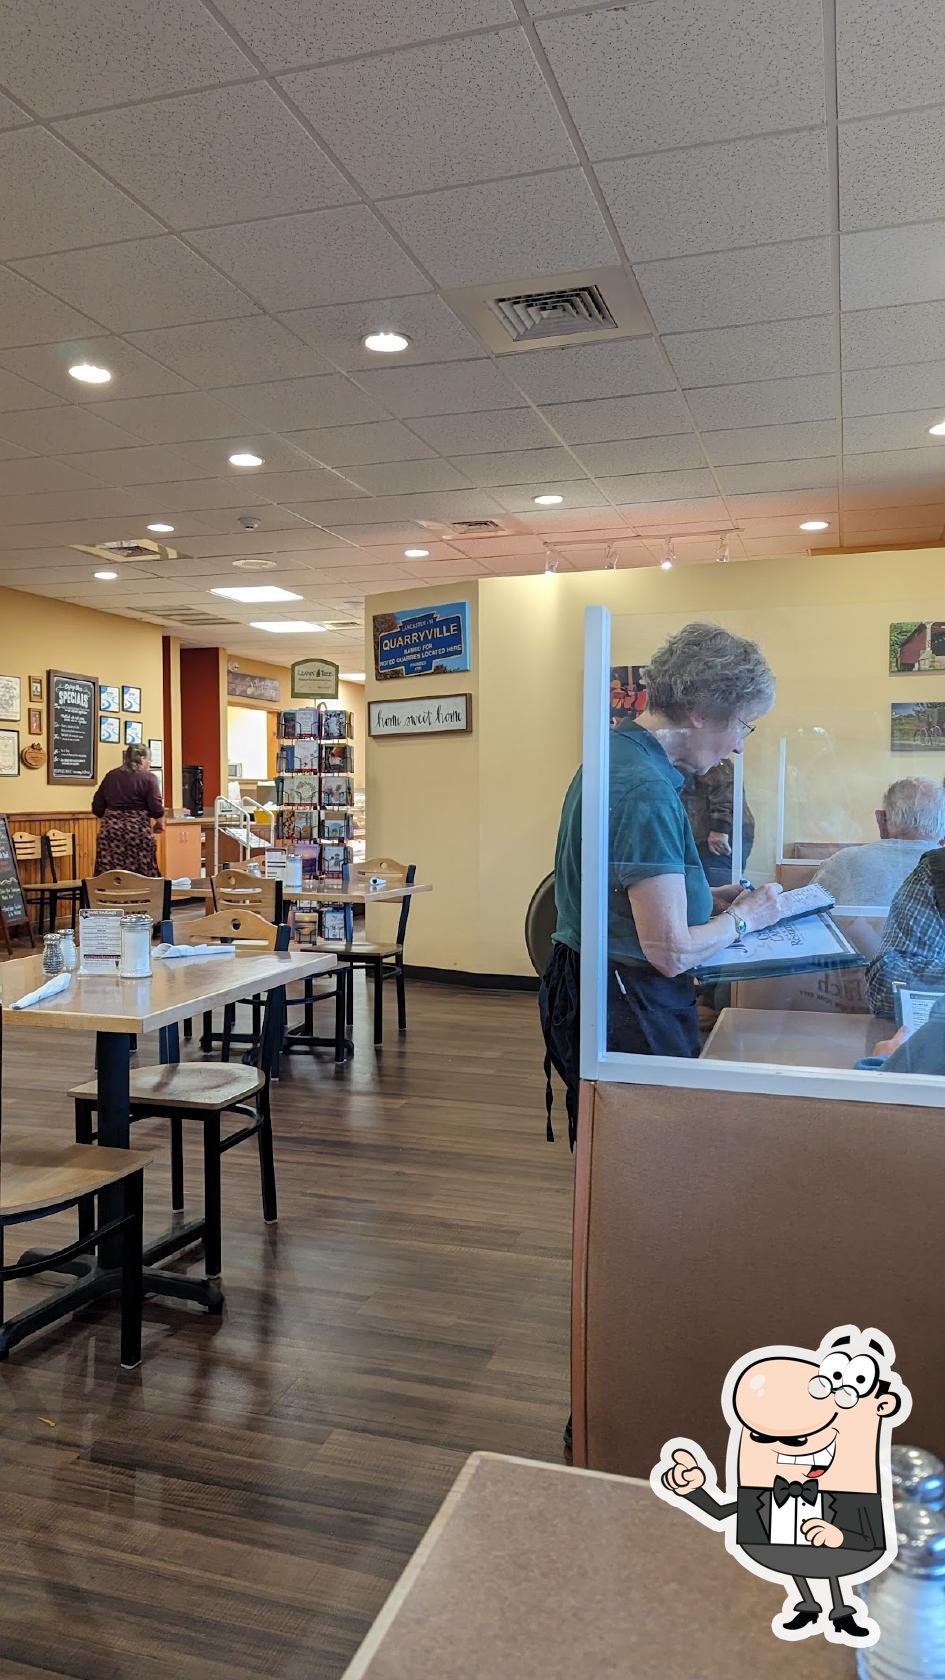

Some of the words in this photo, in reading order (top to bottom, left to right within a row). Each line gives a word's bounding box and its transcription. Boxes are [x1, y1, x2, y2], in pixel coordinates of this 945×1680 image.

[383, 623, 458, 650] QUARRYVILLE
[422, 643, 432, 651] FOR
[380, 658, 396, 667] NOTED
[421, 647, 446, 658] LOCATED
[446, 644, 462, 652] HERE
[58, 690, 89, 709] SPECIALS
[376, 710, 401, 728] home
[404, 709, 433, 727] sweet
[435, 704, 462, 724] home
